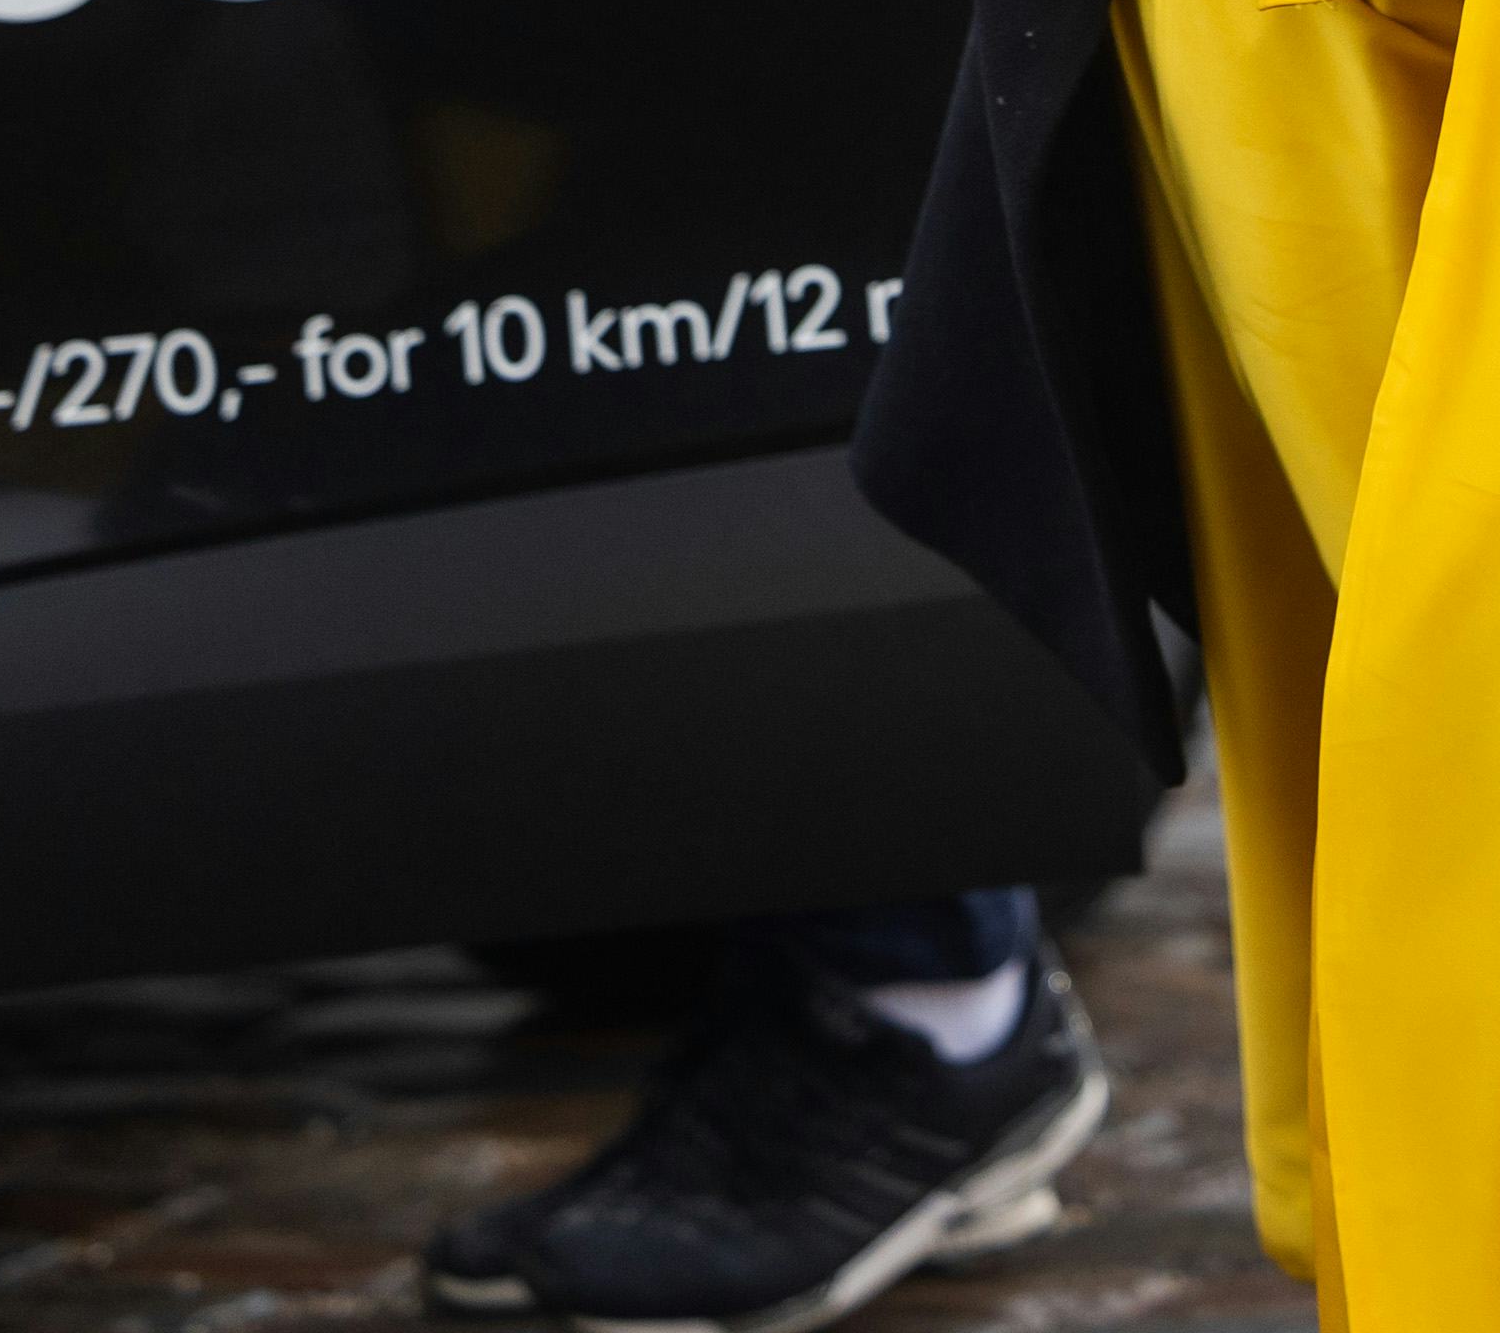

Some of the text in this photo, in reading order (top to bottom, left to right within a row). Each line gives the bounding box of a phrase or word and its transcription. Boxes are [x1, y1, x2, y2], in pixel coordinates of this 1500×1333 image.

[293, 314, 425, 401] for
[444, 294, 546, 385] 10
[567, 263, 848, 374] km/12
